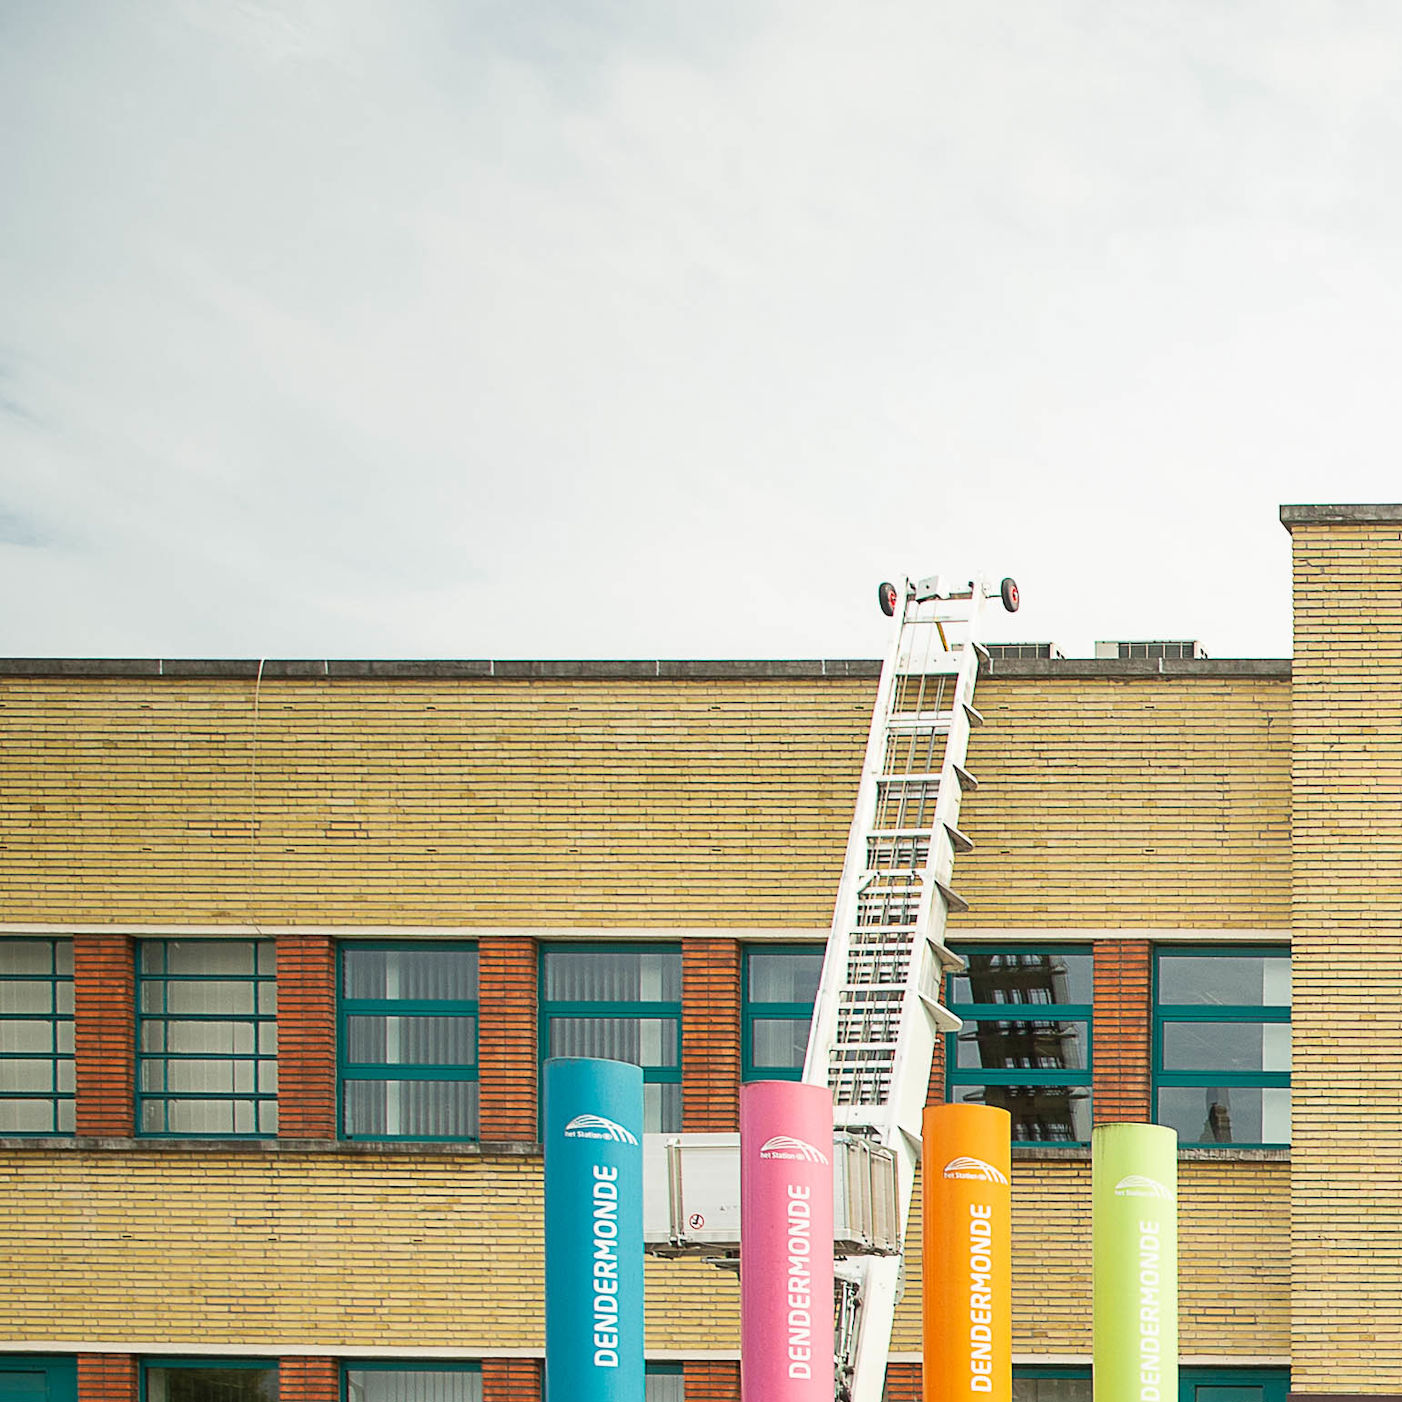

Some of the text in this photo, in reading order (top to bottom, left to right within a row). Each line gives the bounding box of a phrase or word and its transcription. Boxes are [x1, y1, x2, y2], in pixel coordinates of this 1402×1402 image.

[593, 1165, 618, 1367] DENDERMONDE
[788, 1185, 811, 1379] DENDERMONDE
[970, 1204, 992, 1392] DENDERMONDE
[1139, 1221, 1160, 1402] DENDERMONDE
